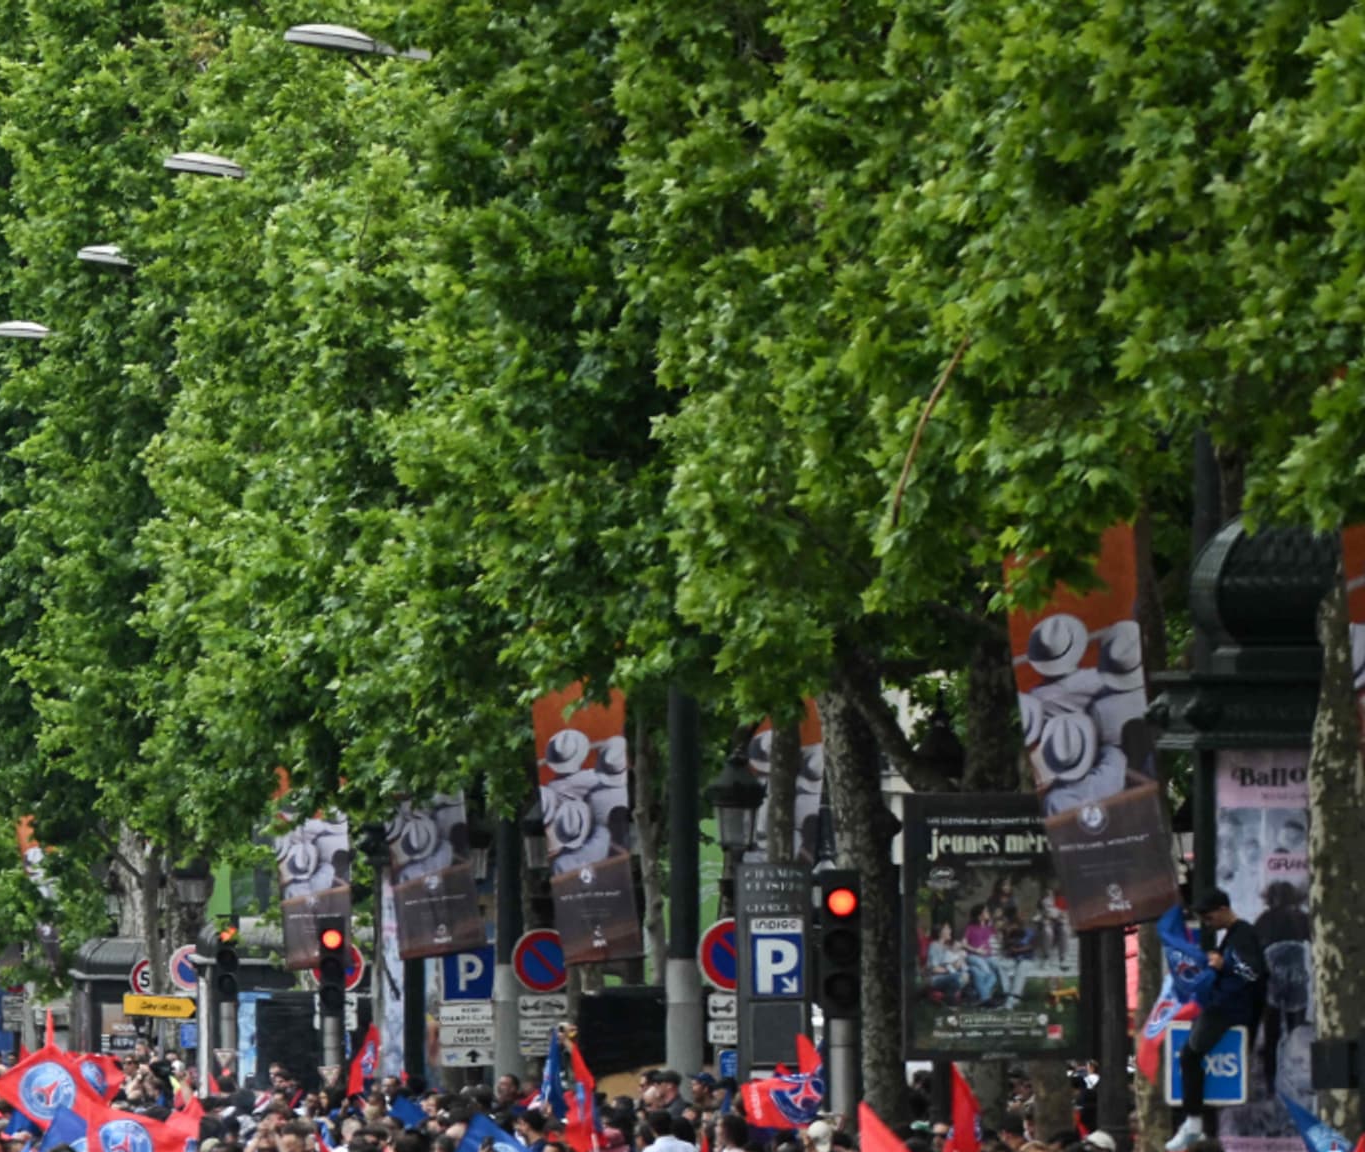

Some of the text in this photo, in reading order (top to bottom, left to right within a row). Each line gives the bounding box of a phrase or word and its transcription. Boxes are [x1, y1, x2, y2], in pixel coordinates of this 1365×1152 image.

[1232, 767, 1307, 787] Ballo
[927, 828, 999, 861] jeunes
[1005, 830, 1052, 853] mèr
[1267, 858, 1309, 870] GRAN
[457, 952, 484, 992] P
[756, 938, 798, 994] P
[140, 971, 150, 988] 5
